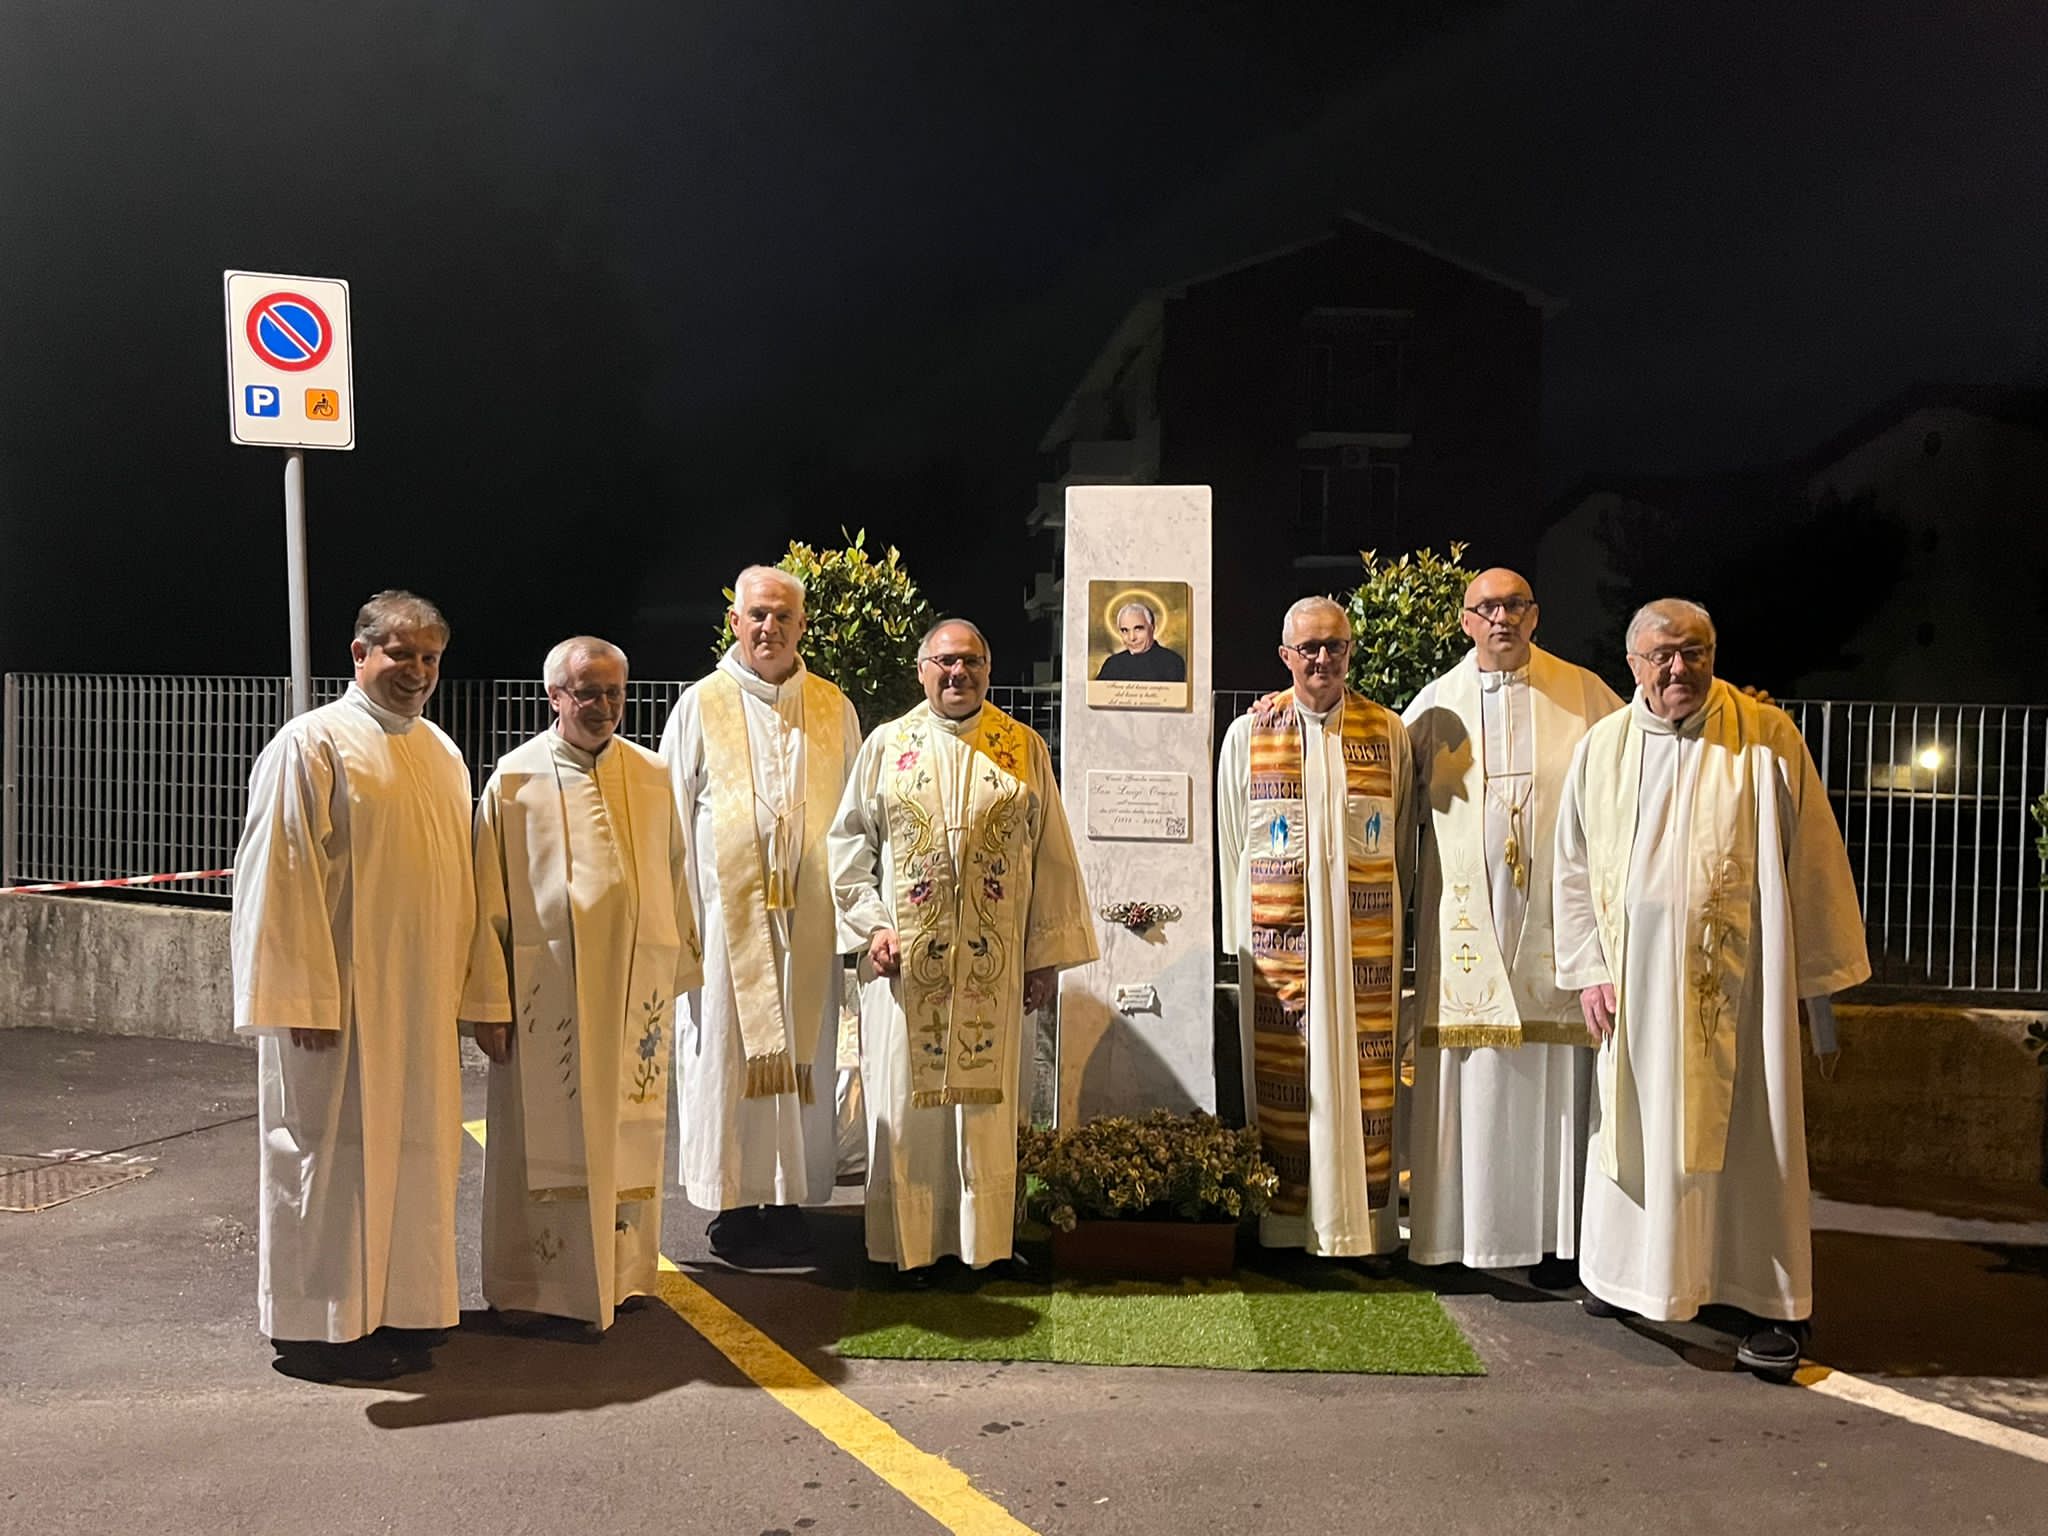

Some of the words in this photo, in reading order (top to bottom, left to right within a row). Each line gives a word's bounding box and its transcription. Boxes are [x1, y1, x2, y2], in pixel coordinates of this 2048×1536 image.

[253, 388, 275, 414] P
[1091, 785, 1110, 795] San
[1116, 785, 1144, 799] Luigi
